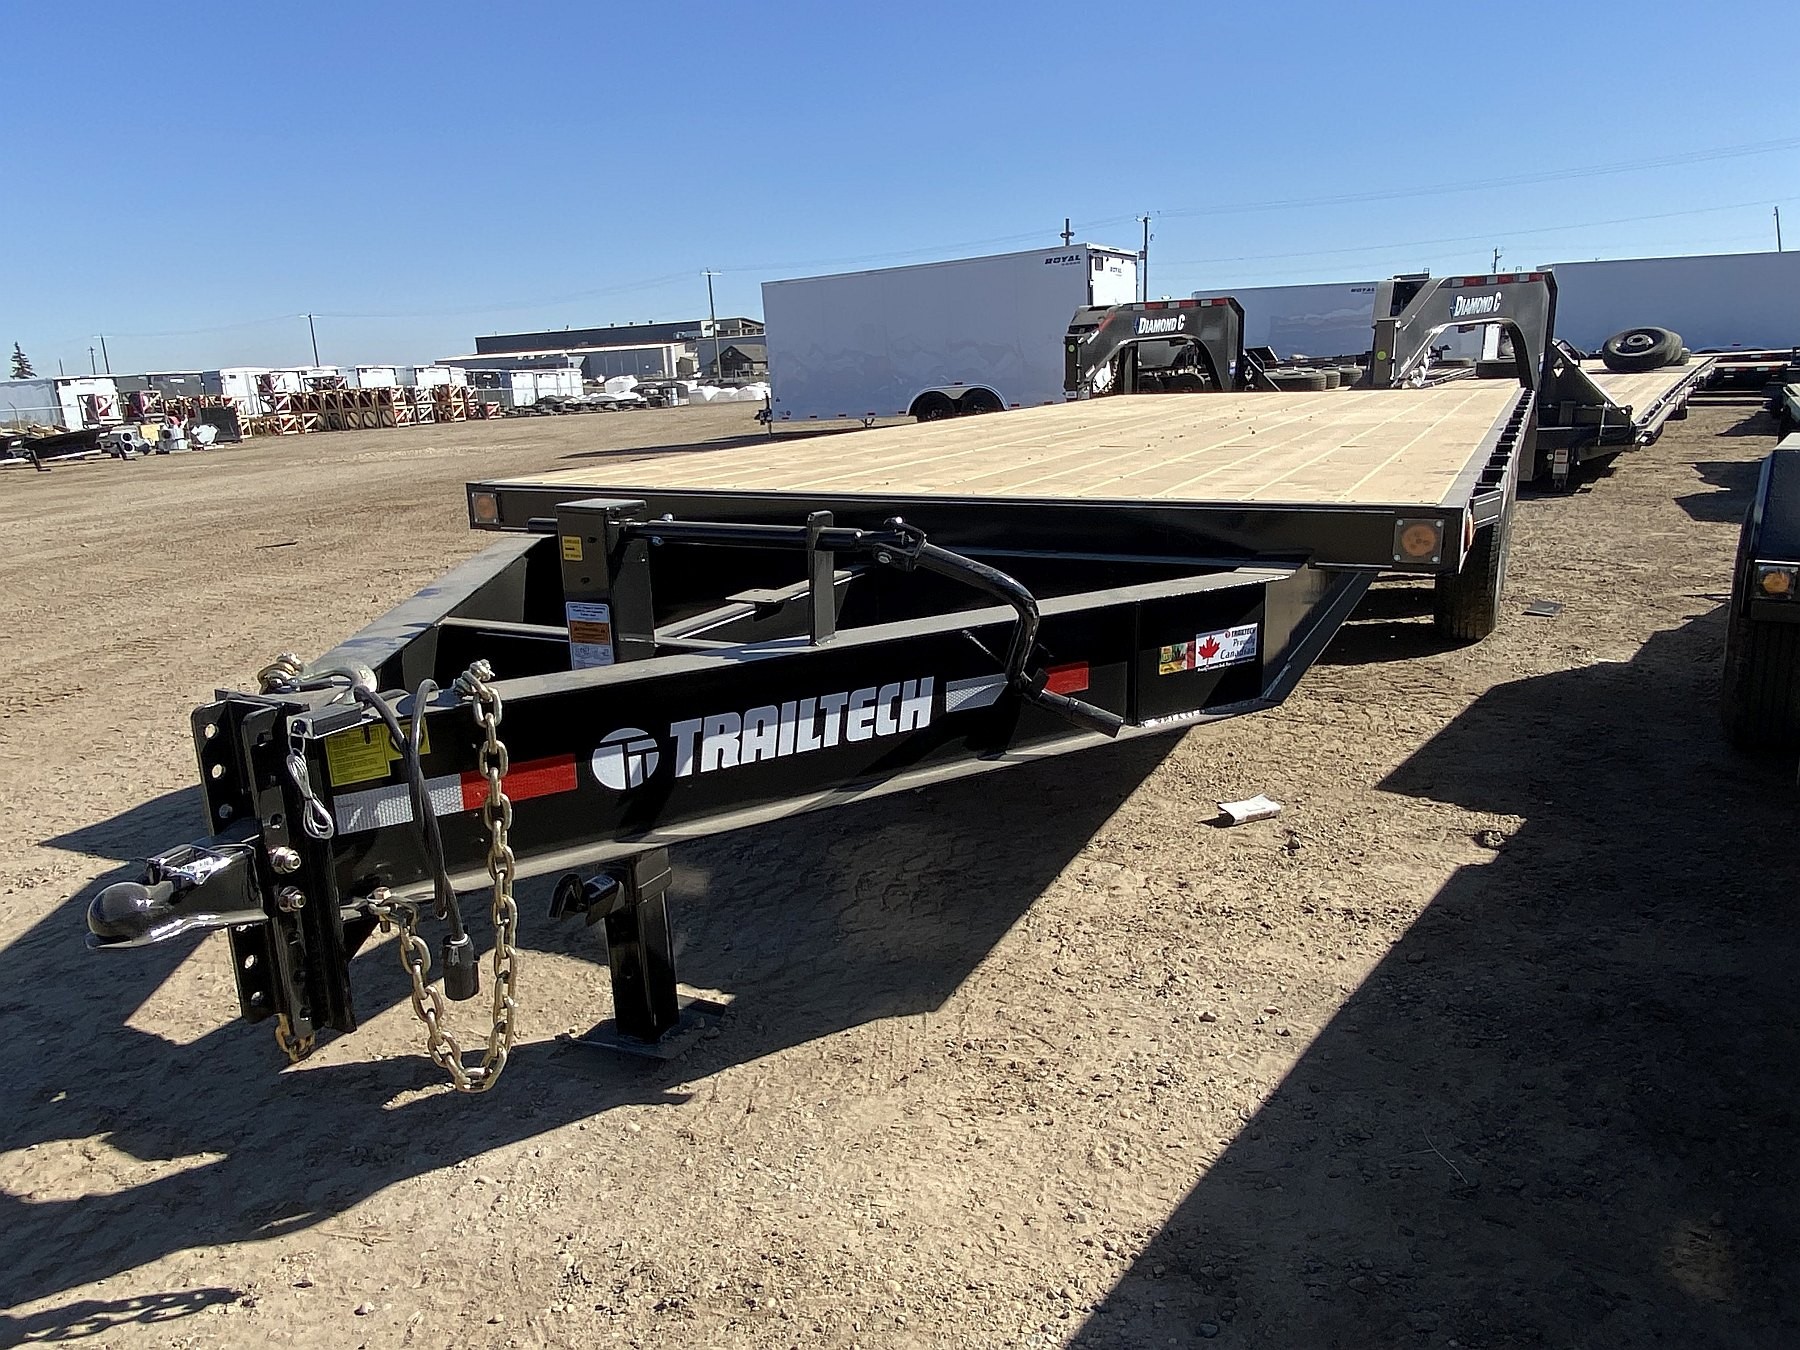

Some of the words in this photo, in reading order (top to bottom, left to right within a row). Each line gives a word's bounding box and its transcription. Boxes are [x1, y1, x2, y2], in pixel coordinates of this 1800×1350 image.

[1045, 255, 1080, 264] ROYAL
[1493, 291, 1502, 312] C
[1138, 317, 1177, 335] DIAMOND
[1177, 313, 1186, 331] C
[669, 675, 935, 778] TRAILTECH
